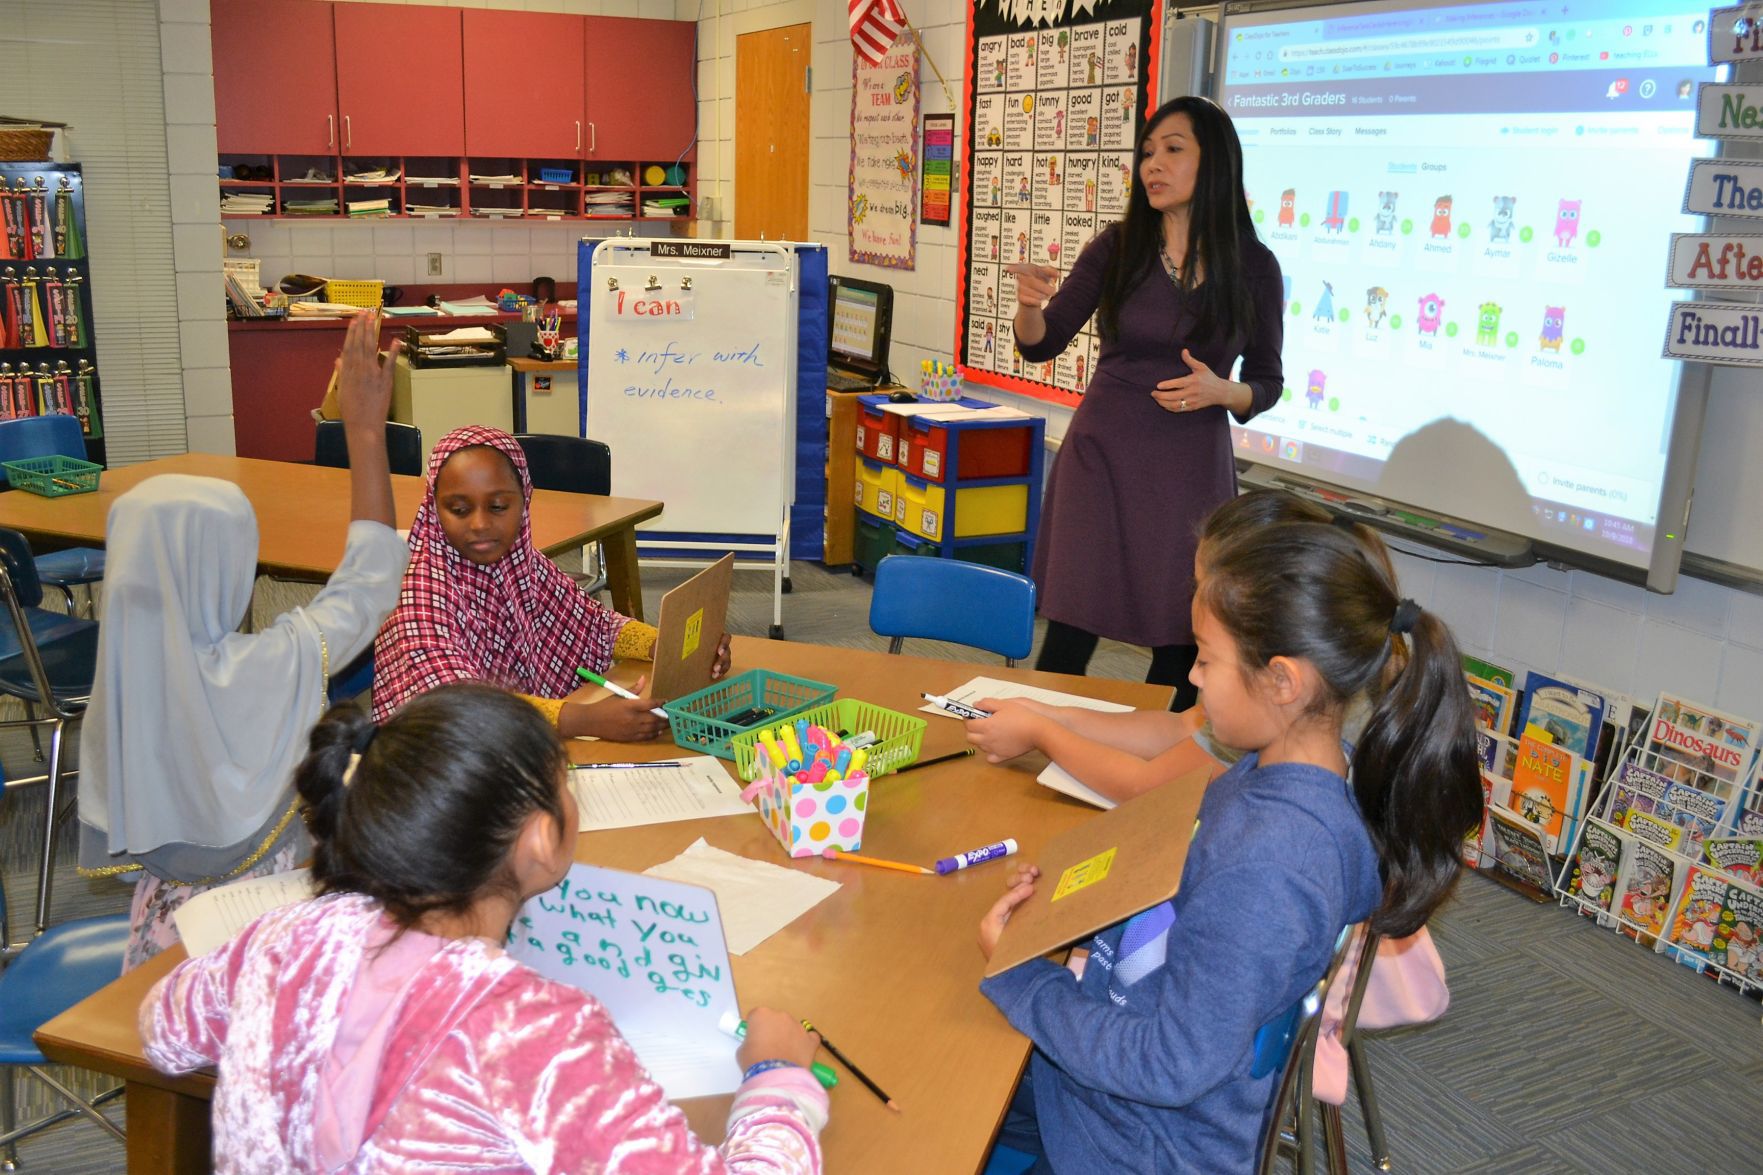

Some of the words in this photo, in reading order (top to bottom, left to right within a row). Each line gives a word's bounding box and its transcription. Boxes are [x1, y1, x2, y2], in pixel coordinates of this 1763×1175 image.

[1074, 29, 1099, 41] brave
[1108, 22, 1127, 37] cold
[981, 41, 1002, 53] angry
[1010, 36, 1025, 48] bad
[1041, 33, 1054, 47] big
[885, 55, 910, 69] CLASS
[871, 93, 892, 106] TEAM
[979, 98, 992, 109] fast
[1008, 97, 1019, 108] fun
[1038, 95, 1060, 109] funny
[1071, 92, 1092, 108] good
[1105, 90, 1120, 106] got
[1234, 94, 1279, 107] Fantastic
[1281, 92, 1299, 106] 3rd
[1302, 91, 1346, 106] Graders
[1270, 127, 1297, 136] Portfolios
[1326, 127, 1342, 138] Story
[1355, 127, 1387, 136] Messages
[976, 155, 998, 168] happy
[1005, 155, 1023, 167] hard
[1035, 156, 1048, 168] hot
[1068, 155, 1097, 171] hungry
[1102, 155, 1120, 168] kind
[1421, 162, 1447, 172] Groups
[869, 203, 878, 212] We
[975, 211, 999, 223] laughed
[1004, 211, 1016, 224] like
[1033, 213, 1051, 225] little
[1065, 214, 1093, 228] looked
[658, 244, 678, 254] Mrs.
[683, 244, 723, 257] Meixner
[1424, 242, 1452, 254] Ahmed
[974, 266, 988, 276] neat
[616, 290, 626, 316] I
[633, 298, 682, 317] can
[971, 318, 985, 330] said
[999, 322, 1010, 336] shy
[638, 341, 701, 375] infer
[712, 343, 764, 367] with
[1531, 355, 1564, 370] Paloma
[624, 378, 723, 405] evidence.
[1553, 477, 1575, 489] Invite
[1576, 483, 1607, 497] parents
[947, 704, 970, 717] EXPO
[1652, 719, 1742, 767] Dinosaurs
[1522, 757, 1564, 784] NATE
[1626, 768, 1668, 791] CAPTAIN
[1669, 786, 1717, 809] CAPTAIN
[1630, 814, 1671, 835] CAPTAIN
[1586, 825, 1616, 846] CAPTAIN
[967, 848, 991, 863] EXPO
[1709, 842, 1755, 855] CAPTAIN
[539, 897, 616, 928] what
[635, 895, 709, 923] now
[556, 942, 631, 979] good
